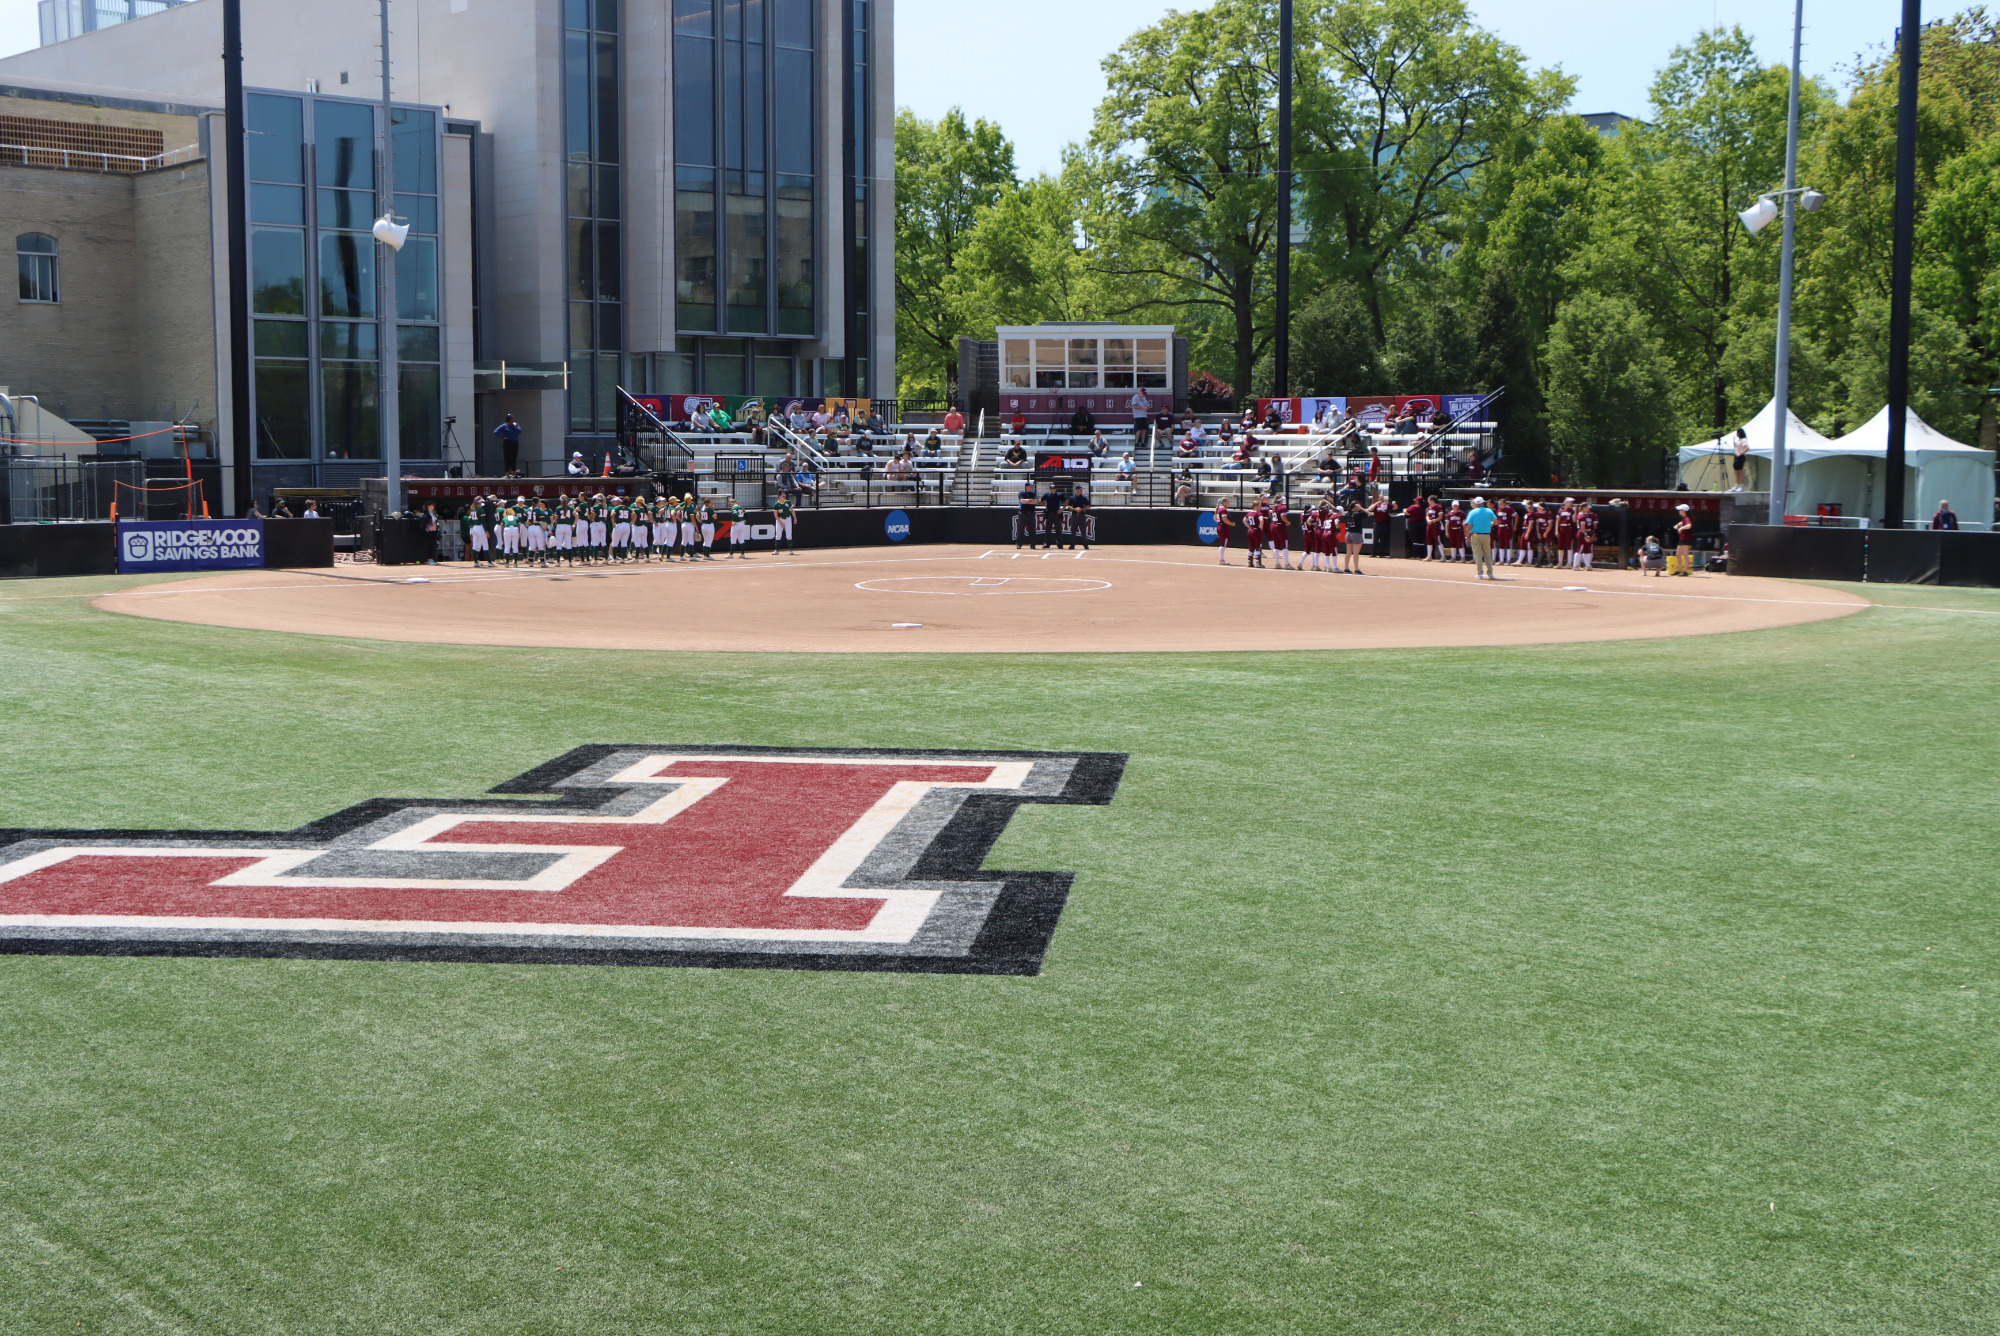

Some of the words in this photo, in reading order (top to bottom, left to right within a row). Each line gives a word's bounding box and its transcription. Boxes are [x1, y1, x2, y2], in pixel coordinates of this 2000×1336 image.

[1039, 456, 1089, 469] A10
[431, 486, 519, 496] FORDHAM
[558, 486, 605, 495] RAMS
[619, 510, 629, 519] 35
[887, 524, 909, 534] NCAA
[154, 529, 260, 547] RIDGEWOOD
[155, 547, 218, 561] SAVINGS
[220, 545, 260, 558] BANK
